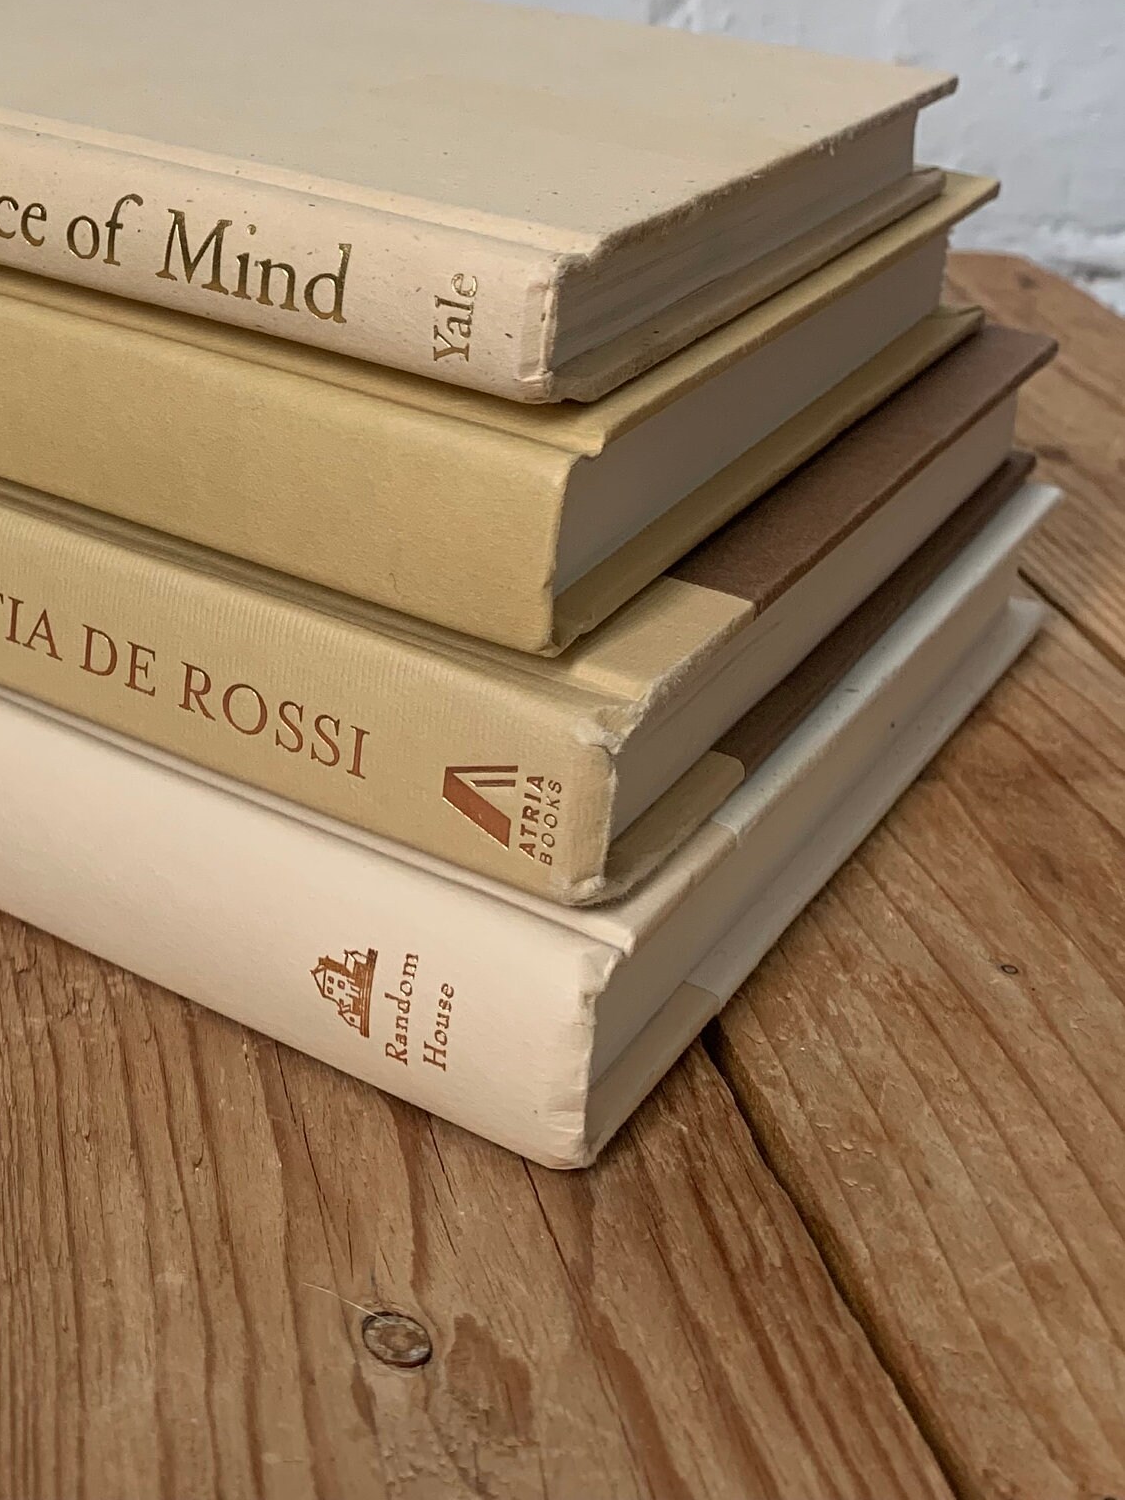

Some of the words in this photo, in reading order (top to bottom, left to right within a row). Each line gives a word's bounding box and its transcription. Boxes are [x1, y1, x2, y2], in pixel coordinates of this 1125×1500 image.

[66, 193, 143, 267] of
[155, 208, 353, 324] Mind
[432, 271, 478, 363] Yale
[79, 624, 157, 697] DE
[178, 660, 371, 780] ROSSI
[518, 774, 545, 861] ATRIA
[539, 779, 564, 866] BOOKS
[385, 953, 419, 1066] Random
[423, 982, 455, 1072] House
